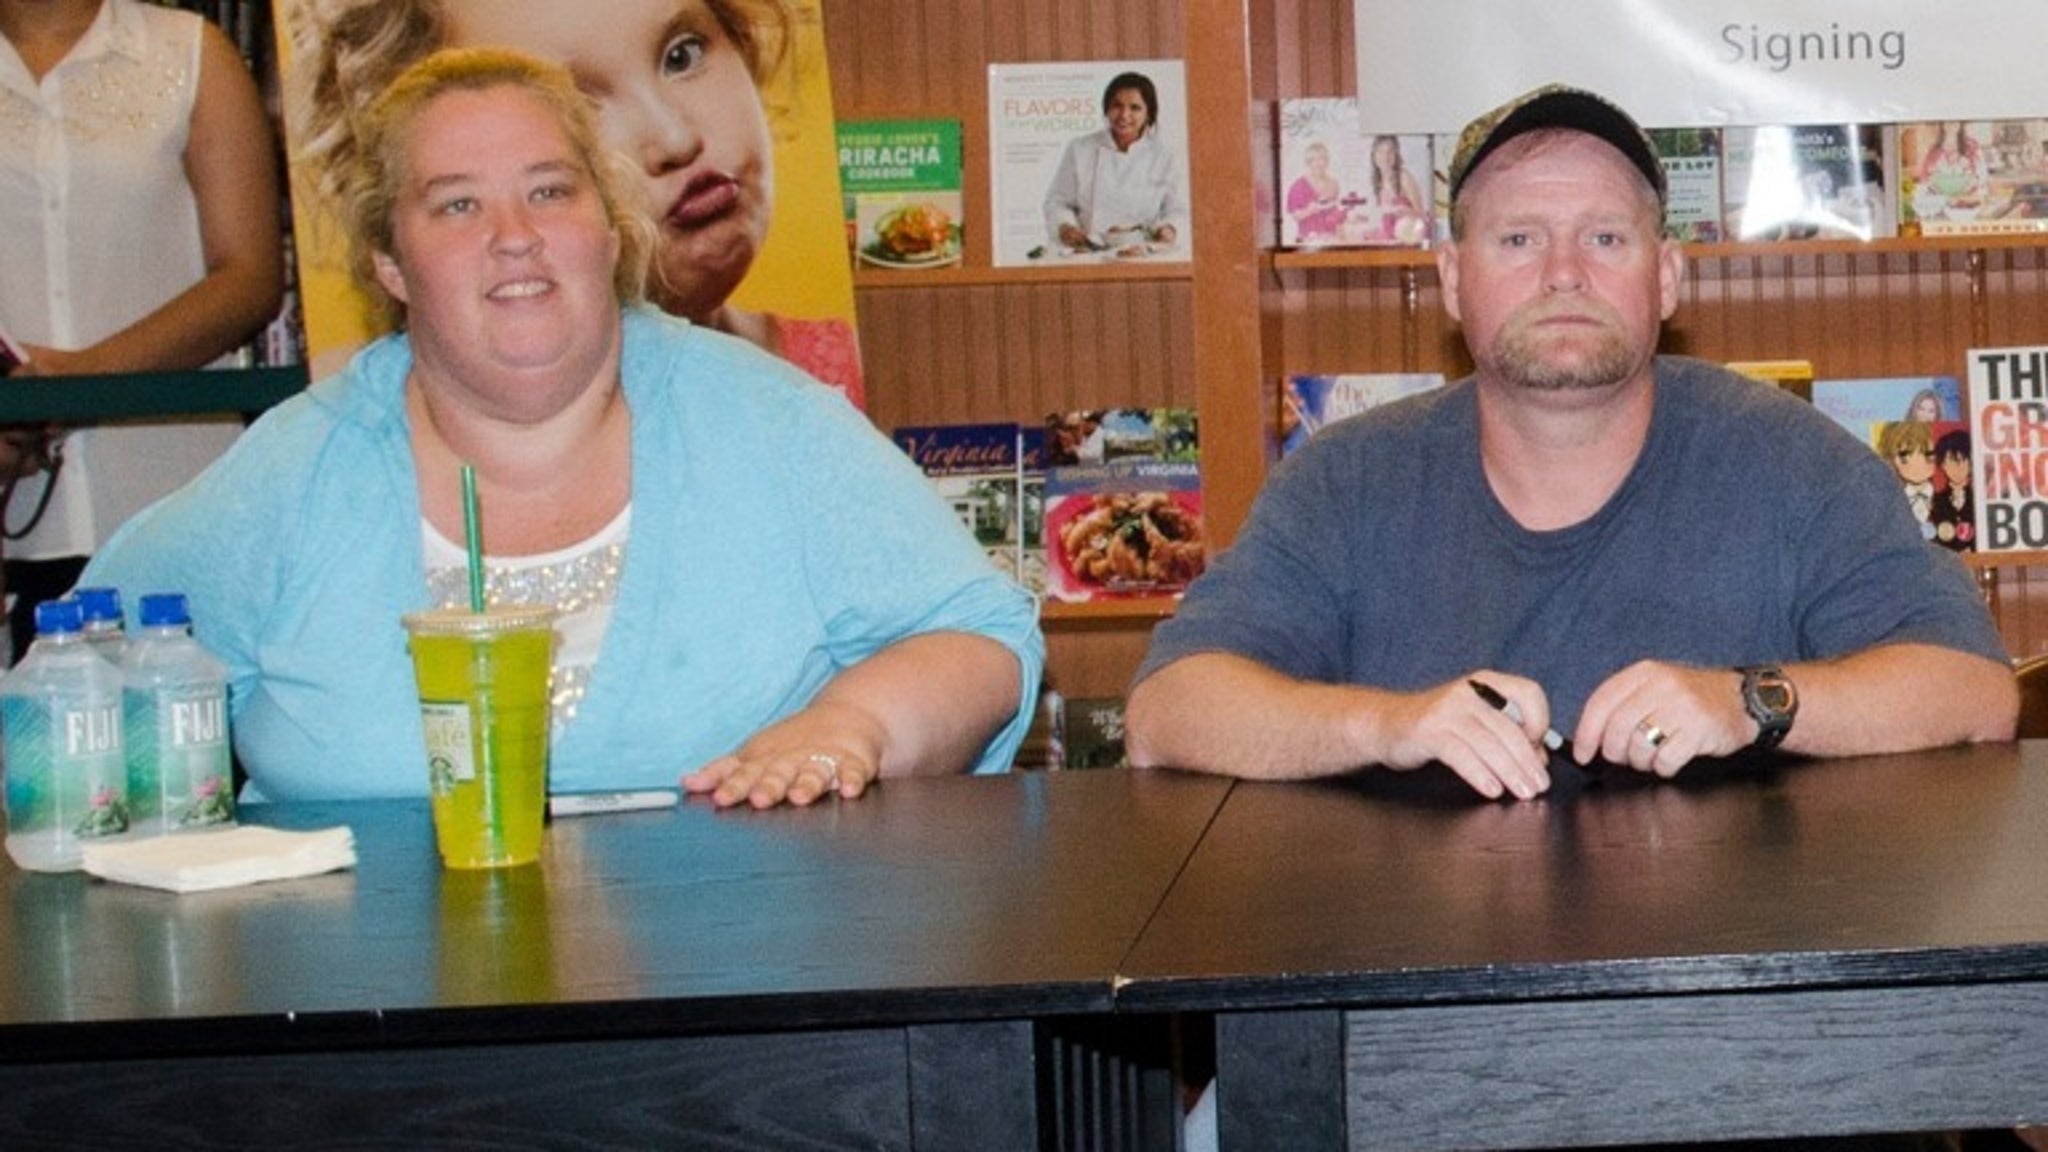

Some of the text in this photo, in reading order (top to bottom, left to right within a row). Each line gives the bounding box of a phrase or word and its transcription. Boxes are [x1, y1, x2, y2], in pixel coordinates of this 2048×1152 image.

[1720, 22, 1906, 73] Signing
[1003, 97, 1096, 118] FLAVORS
[839, 145, 941, 166] RIRACHA
[1978, 352, 2048, 401] TH
[1981, 401, 2048, 451] GR
[905, 433, 1008, 472] Virginia
[1137, 464, 1198, 477] VIRGINIA
[1986, 501, 2048, 549] BO
[65, 706, 119, 755] FIJI
[171, 698, 223, 747] FIJI
